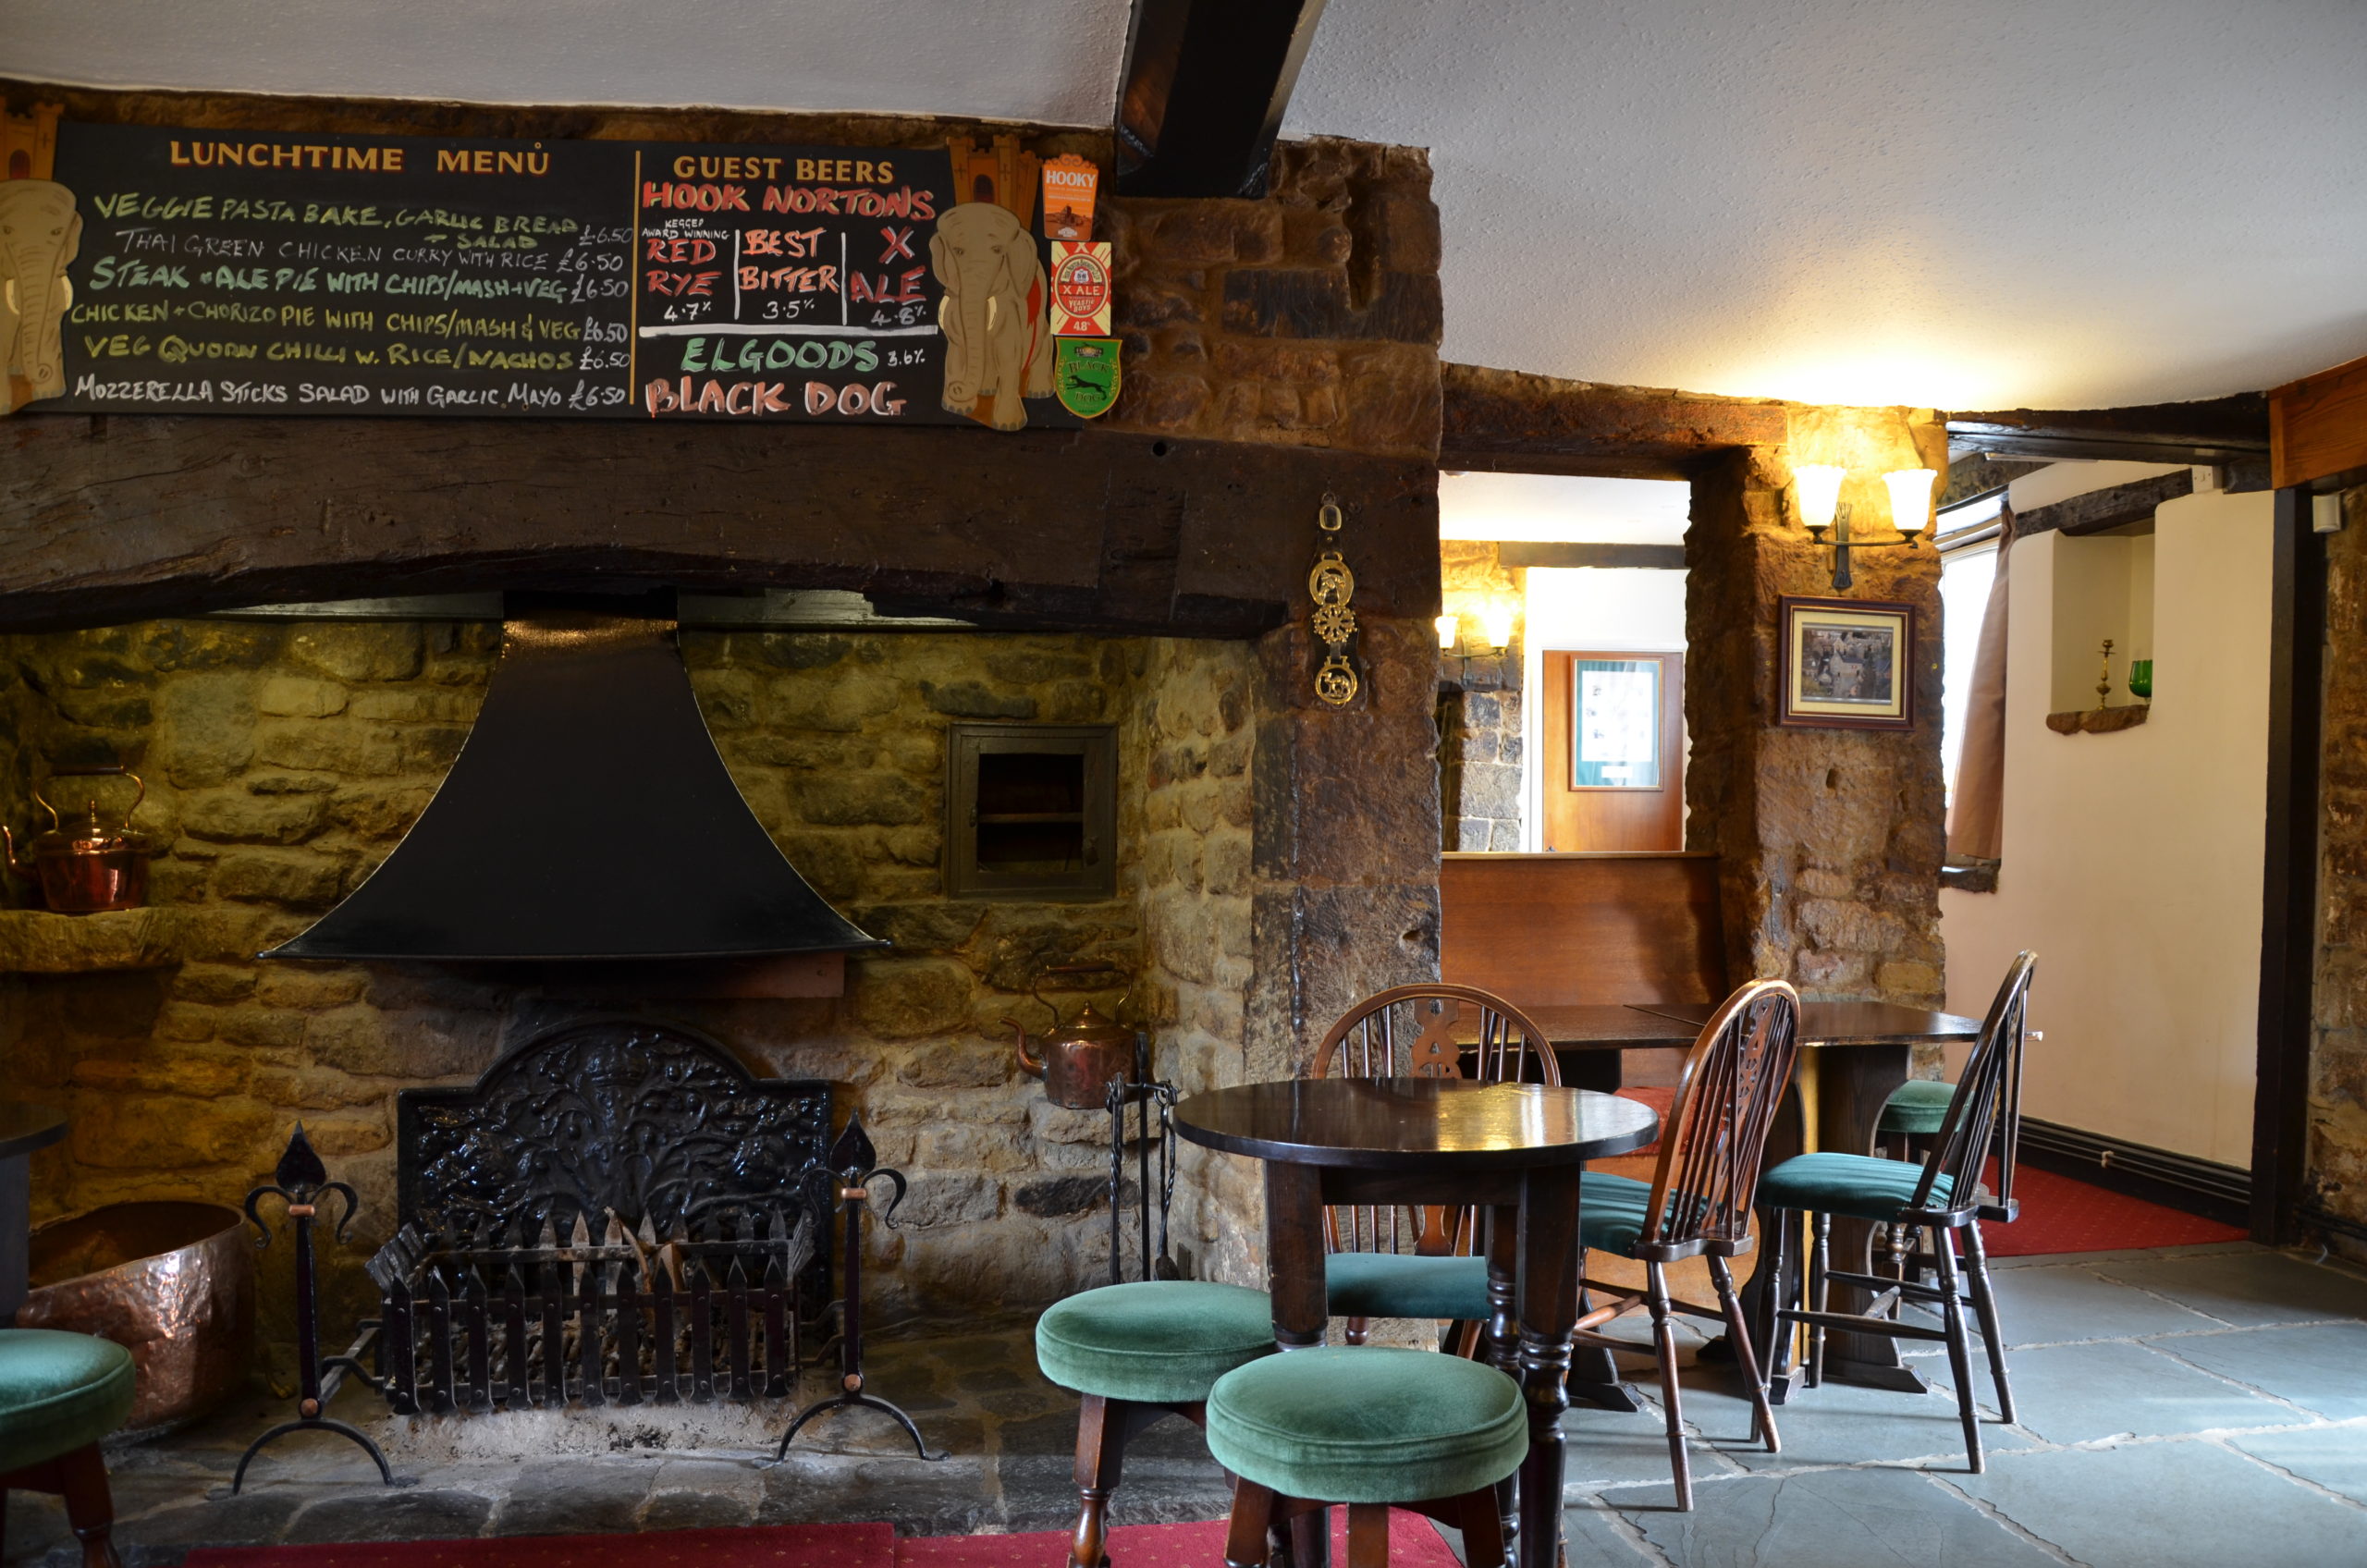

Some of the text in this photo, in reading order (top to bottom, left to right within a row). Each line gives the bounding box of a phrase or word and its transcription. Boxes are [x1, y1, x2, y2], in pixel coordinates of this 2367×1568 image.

[170, 141, 404, 172] LUNCHTIME
[673, 155, 894, 184] GUEST BEERS
[1046, 169, 1097, 188] HOOKY
[93, 192, 214, 221] VEGGIE
[220, 199, 296, 222] PASTA
[395, 208, 484, 230] GARLIC
[494, 214, 579, 234] BREAD
[642, 181, 937, 221] HOOK NORTONS
[642, 227, 730, 240] AWARD WINNING
[666, 218, 704, 229] KEGGED
[116, 227, 176, 254] THAI
[184, 234, 265, 258] GREEN
[278, 241, 382, 263] CHICKEN
[392, 247, 452, 267] CURRY
[458, 251, 495, 268] WITH
[500, 251, 549, 271] RICE
[457, 233, 538, 250] SALAD
[647, 238, 717, 265] RED
[742, 227, 827, 258] BEST
[879, 225, 915, 265] X
[89, 255, 190, 290] STEAK
[215, 264, 269, 290] ALE
[275, 266, 320, 292] PIE
[326, 271, 379, 294] WITH
[645, 269, 722, 298] RYE
[738, 264, 840, 294] BITTER
[850, 265, 927, 304] ALE
[1063, 285, 1100, 296] X ALE
[70, 299, 169, 324] CHICKEN
[187, 300, 276, 323] CHORIZO
[281, 304, 315, 326] PIE
[325, 308, 374, 331] WITH
[539, 319, 581, 341] VEG
[83, 334, 152, 359] VEG
[157, 334, 258, 363] QUORN
[266, 341, 347, 363] CHILLI
[681, 337, 879, 374] ELGOODS
[74, 373, 214, 402] MOZZERELLA
[220, 380, 288, 403] STICKS
[298, 383, 370, 406] SALAD
[380, 386, 420, 407] WITH
[426, 384, 499, 409] GARLIC
[508, 382, 562, 408] MAYO
[645, 375, 908, 417] BLACK DOG
